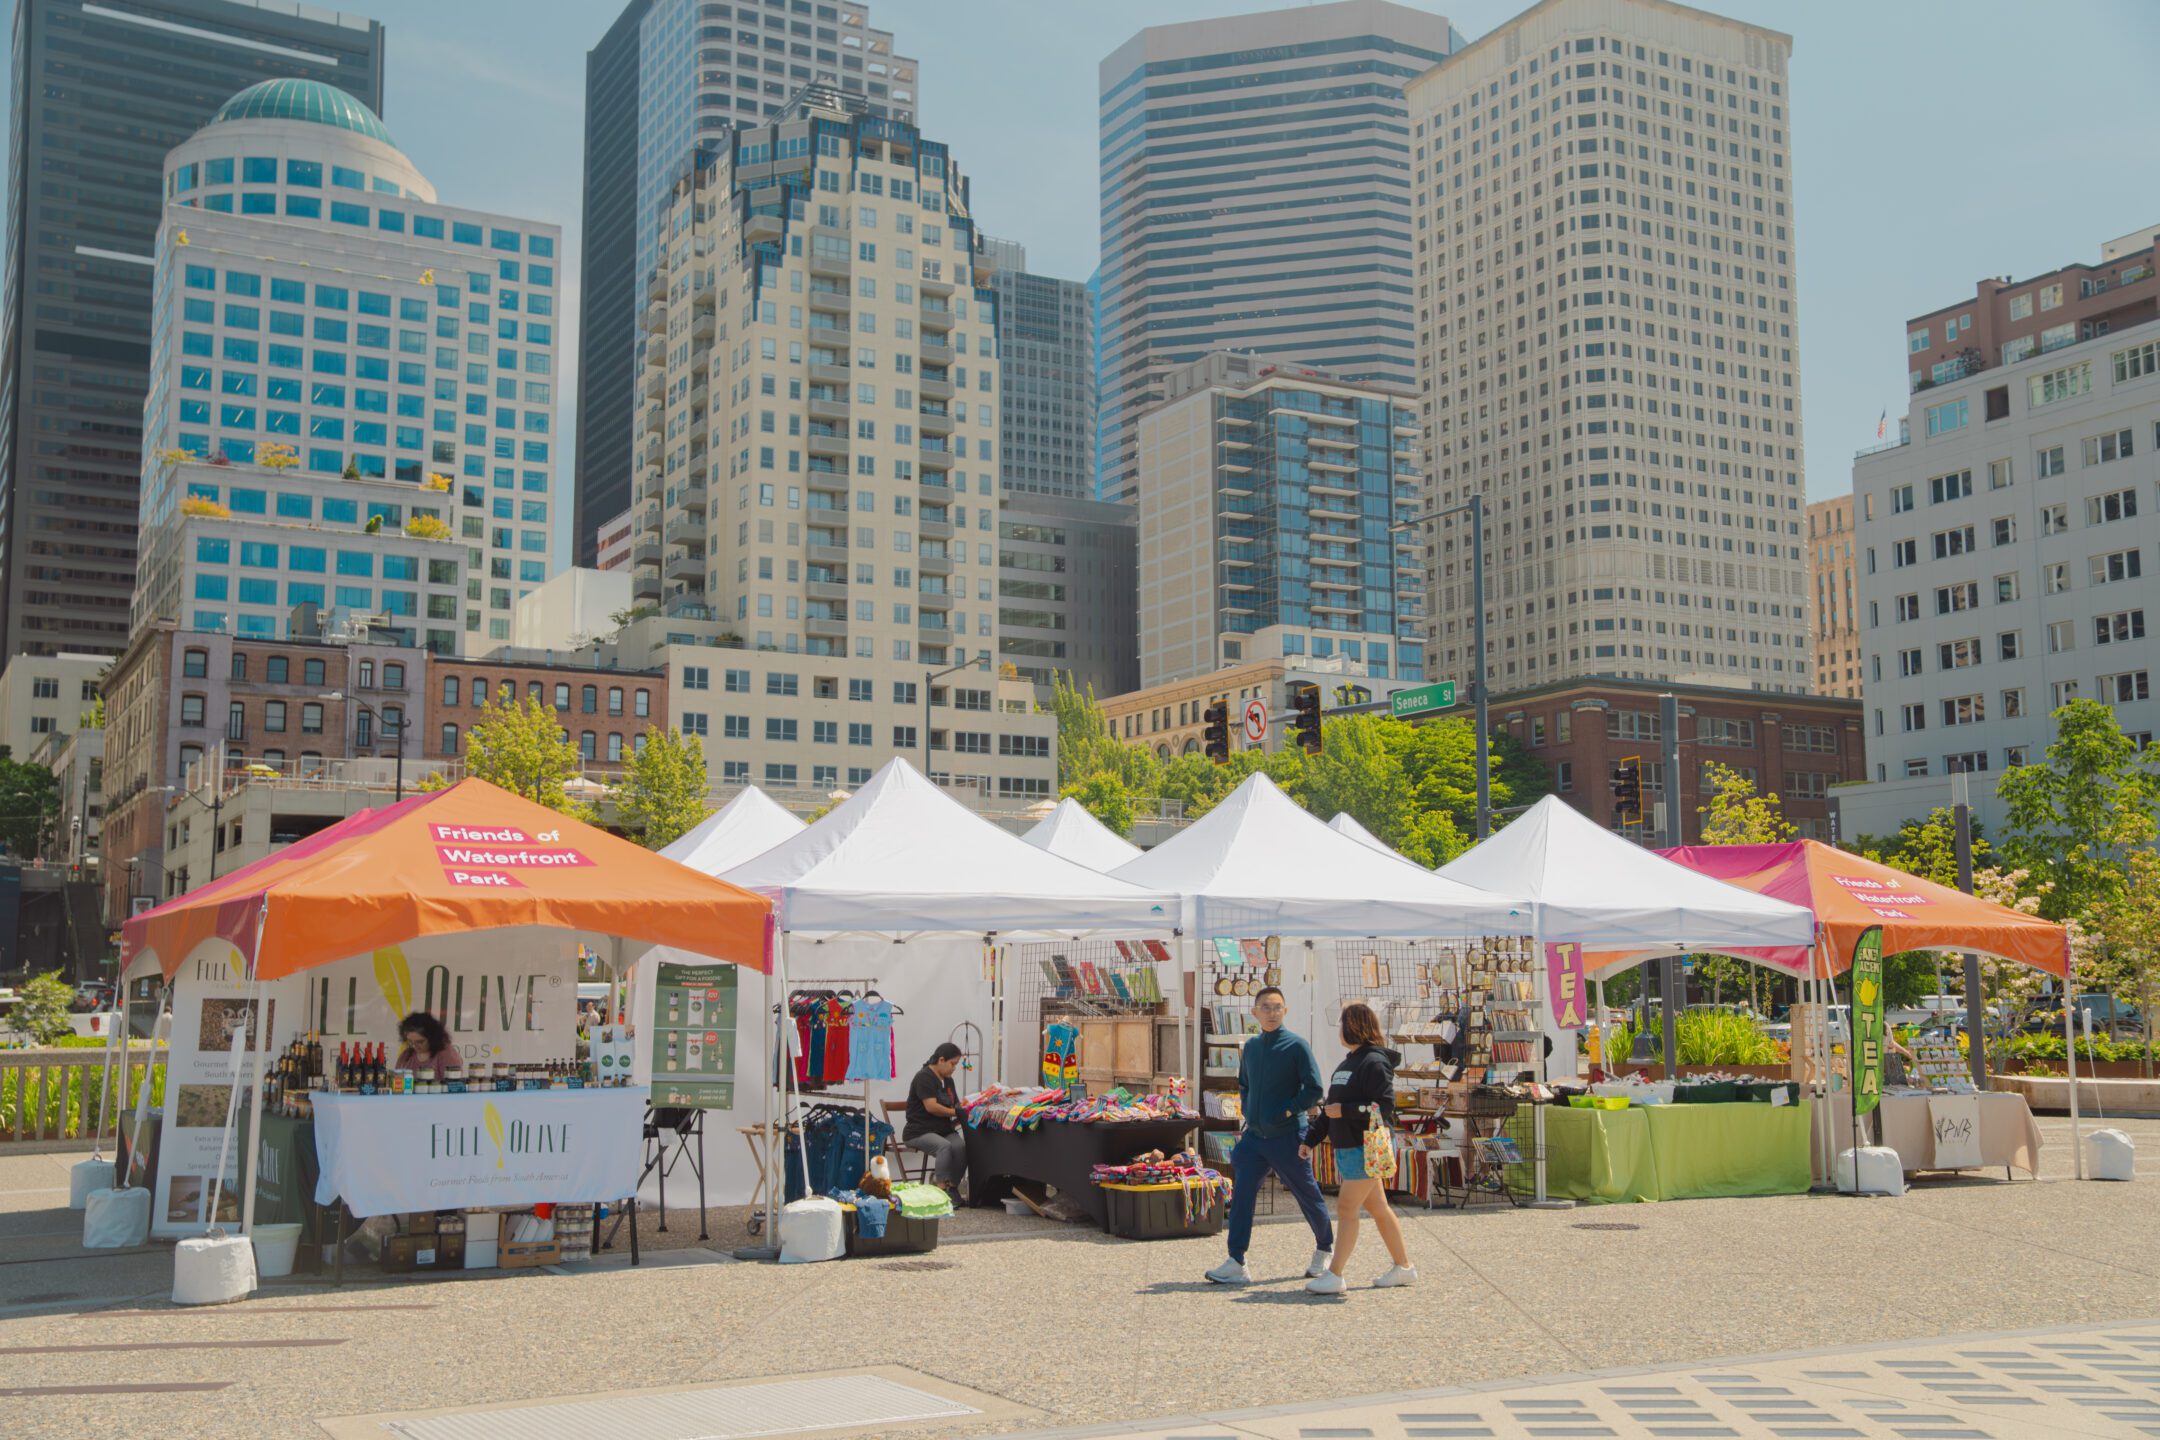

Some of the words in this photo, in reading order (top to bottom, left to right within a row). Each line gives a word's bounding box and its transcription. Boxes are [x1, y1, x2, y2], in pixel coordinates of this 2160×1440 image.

[1396, 694, 1428, 710] Seneca
[1442, 689, 1452, 701] St
[437, 826, 525, 841] Friends
[537, 830, 560, 842] of
[443, 848, 579, 864] Waterfront
[453, 871, 510, 886] Park
[1833, 877, 1883, 889] Friends
[1852, 892, 1926, 904] Waterfront
[1556, 943, 1582, 1028] TEA
[425, 964, 547, 1032] OLIVE
[1861, 1012, 1879, 1095] TEA
[432, 1122, 484, 1159] FULL
[510, 1118, 573, 1154] OLIVE
[430, 1176, 467, 1188] Gourmet
[490, 1174, 511, 1185] from
